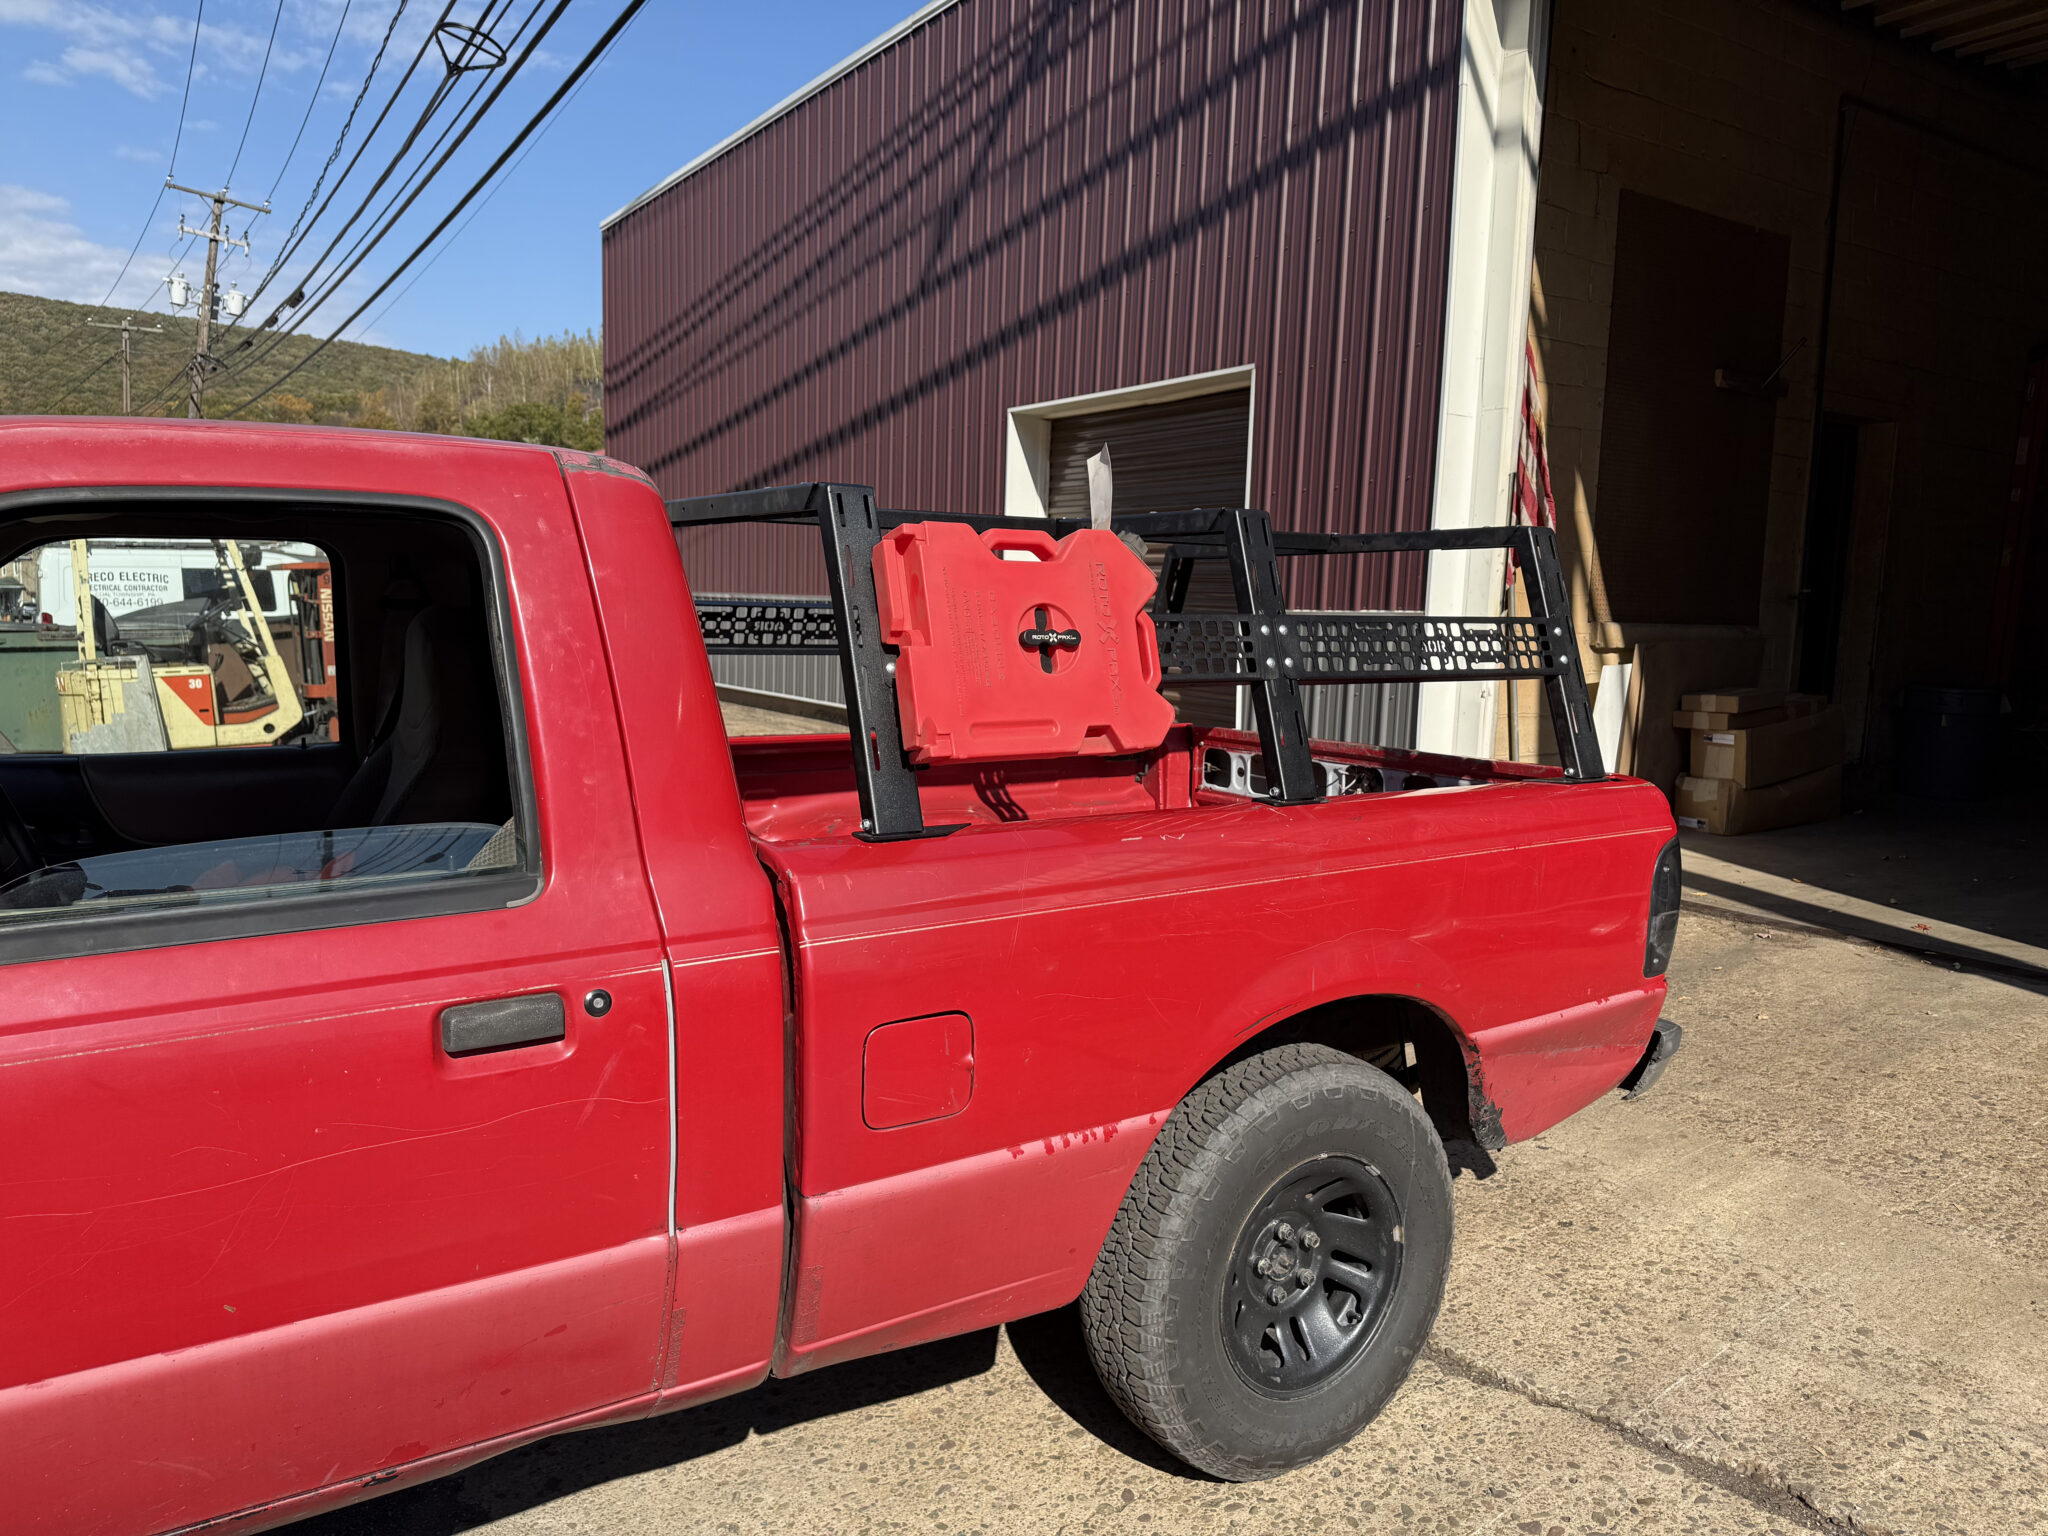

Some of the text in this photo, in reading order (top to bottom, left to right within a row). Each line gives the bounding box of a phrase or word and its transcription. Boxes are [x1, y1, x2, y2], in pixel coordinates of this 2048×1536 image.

[88, 572, 169, 584] RECO ELECTRIC
[89, 584, 168, 592] ECTRICAL CONTRACTOR
[100, 597, 163, 607] 0-644-6199
[320, 588, 335, 642] NISSAN
[188, 678, 203, 689] 30
